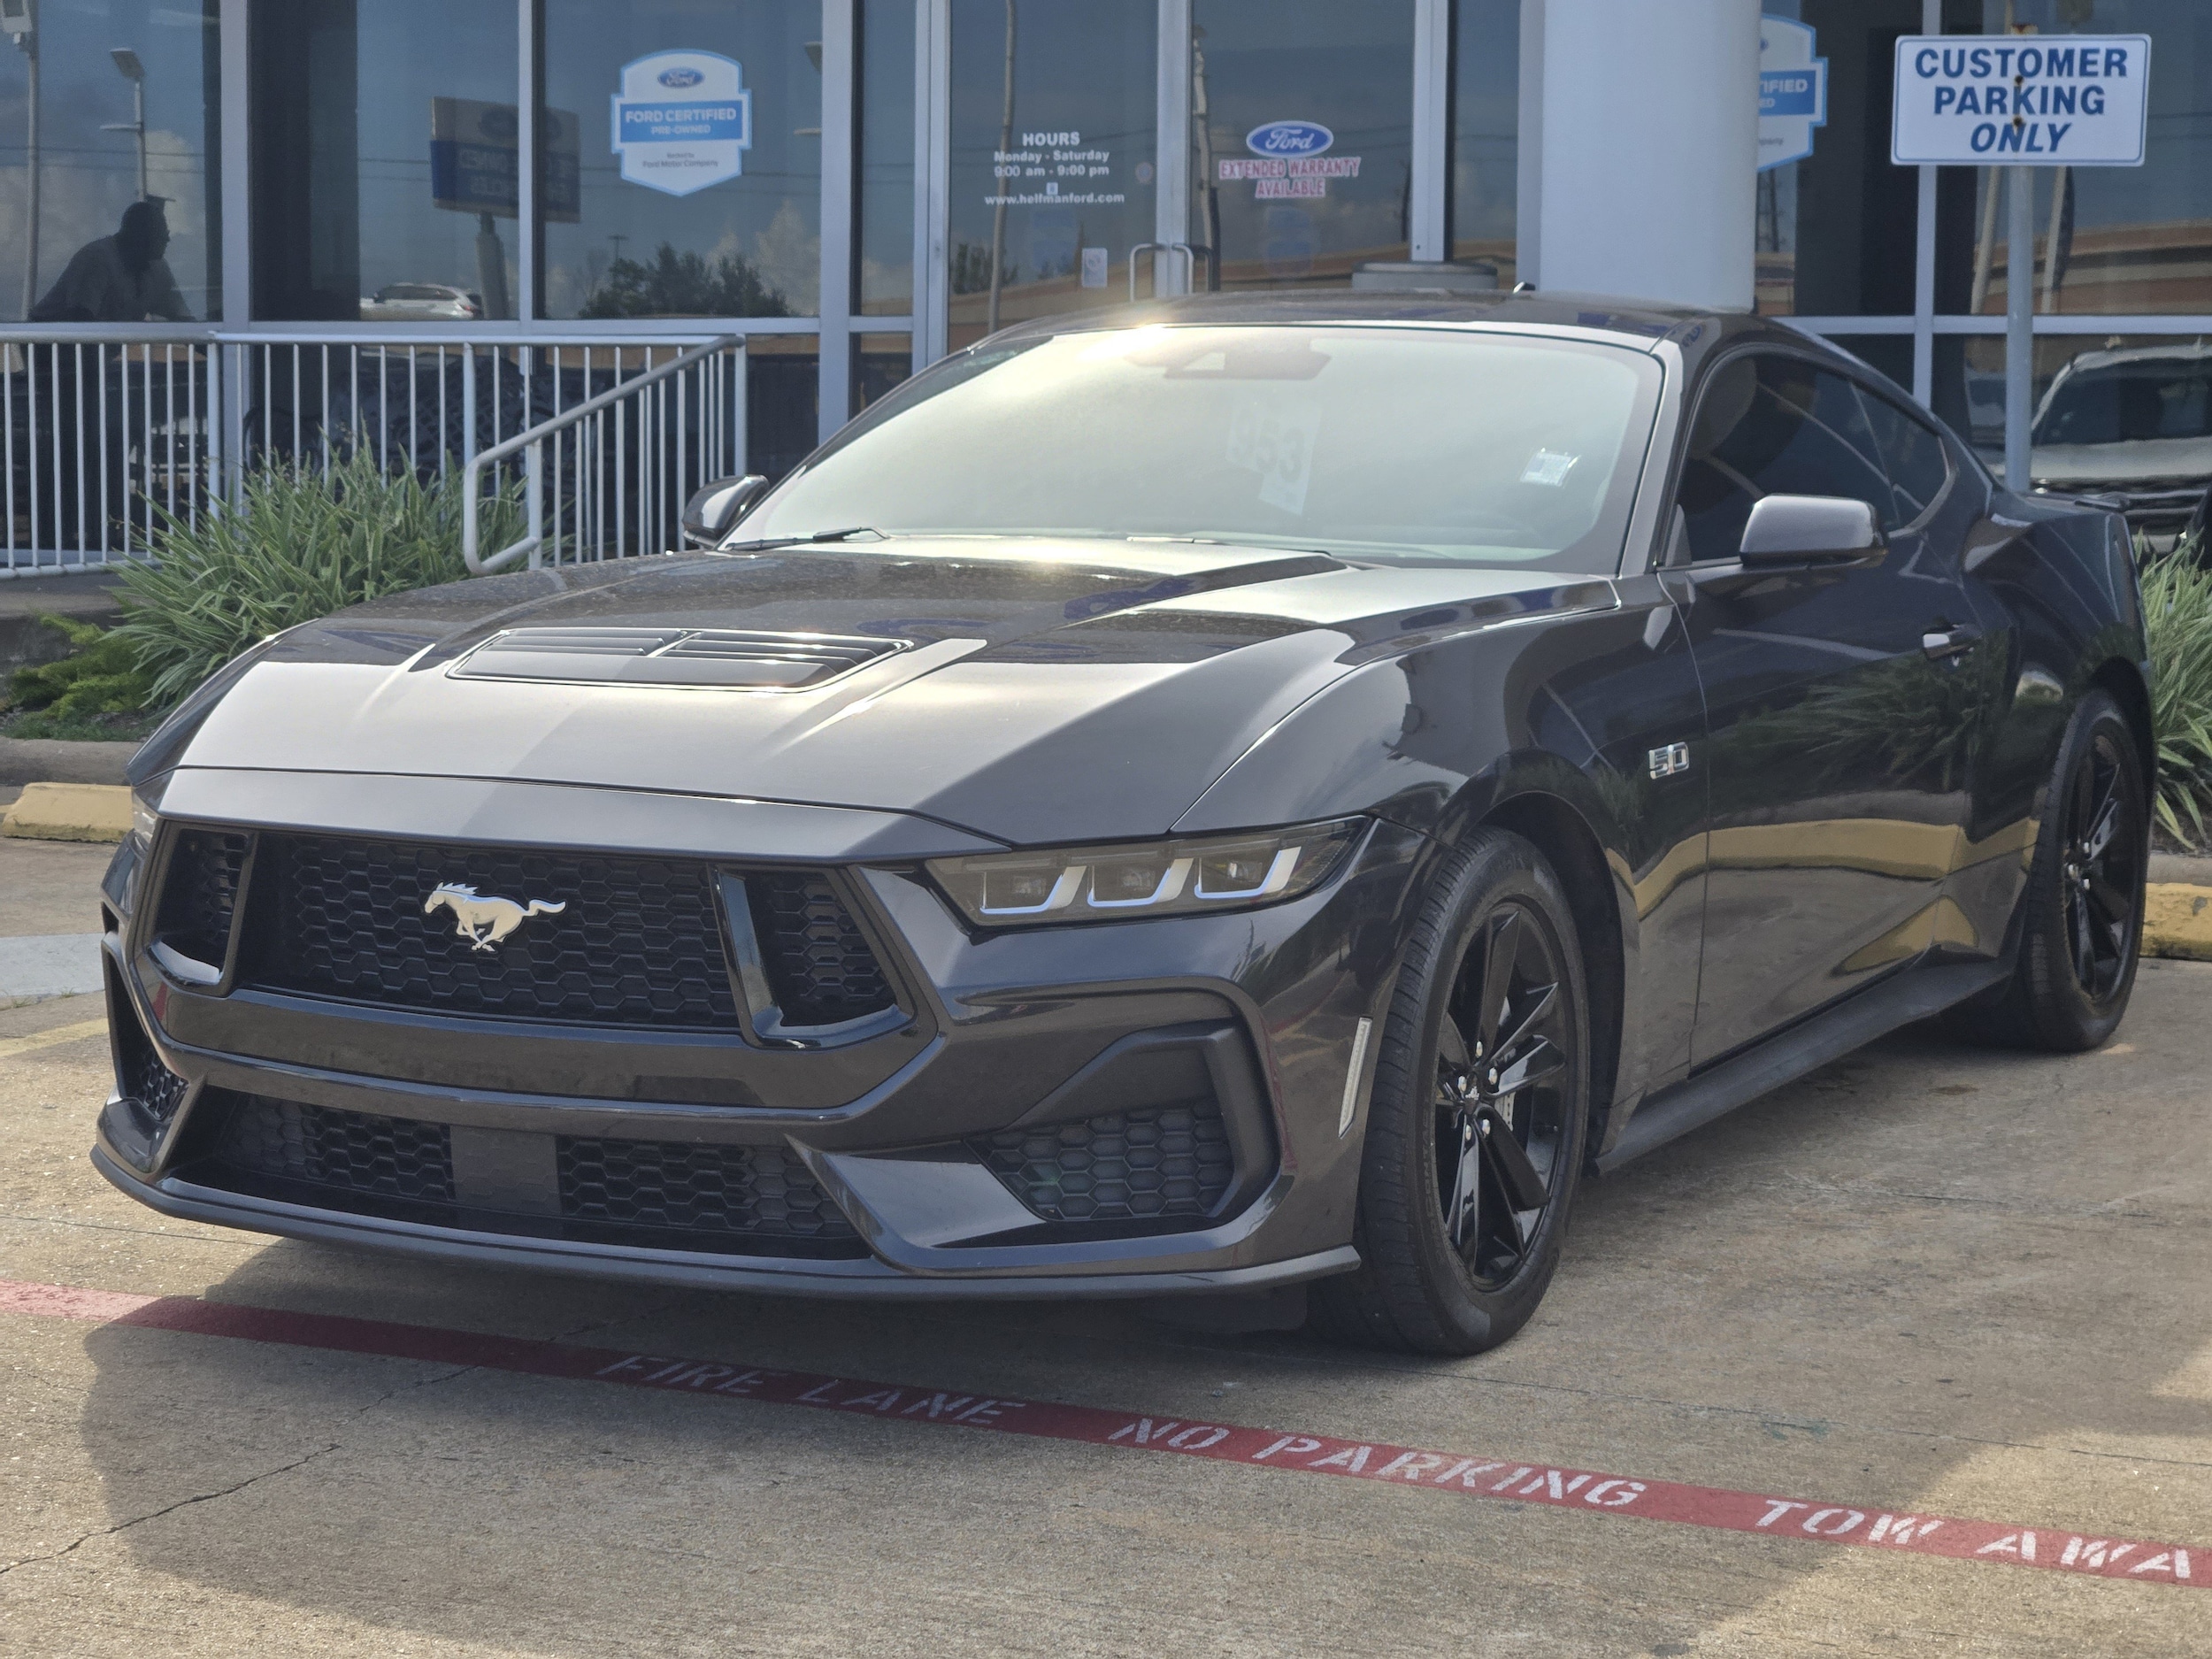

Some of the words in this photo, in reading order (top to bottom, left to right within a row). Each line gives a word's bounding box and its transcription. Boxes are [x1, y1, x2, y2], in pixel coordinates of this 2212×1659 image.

[1915, 48, 2128, 78] CUSTOMER
[1760, 79, 1809, 94] IFIED
[1933, 85, 2105, 115] PARKING
[625, 110, 664, 123] FORD
[665, 108, 737, 122] CERTIFIED
[650, 125, 711, 135] PRE-OWNED
[1022, 132, 1080, 146] HOURS
[1264, 128, 1316, 150] Ford
[1970, 122, 2072, 153] ONLY
[994, 150, 1042, 164] Monday
[1053, 150, 1110, 163] Saturday
[994, 165, 1020, 177] 9:00
[1025, 166, 1045, 176] am
[1057, 165, 1086, 176] 9:00
[1089, 165, 1110, 177] pm
[1219, 160, 1286, 178] EXTENDED
[1288, 157, 1360, 177] WARRANTY
[1256, 179, 1325, 197] AVAILABLE
[595, 1354, 789, 1394] FIRE
[796, 1379, 1026, 1425] LANE
[1108, 1417, 1228, 1450] NO
[1252, 1434, 1647, 1507] PARKING
[1755, 1499, 1946, 1546] TOW
